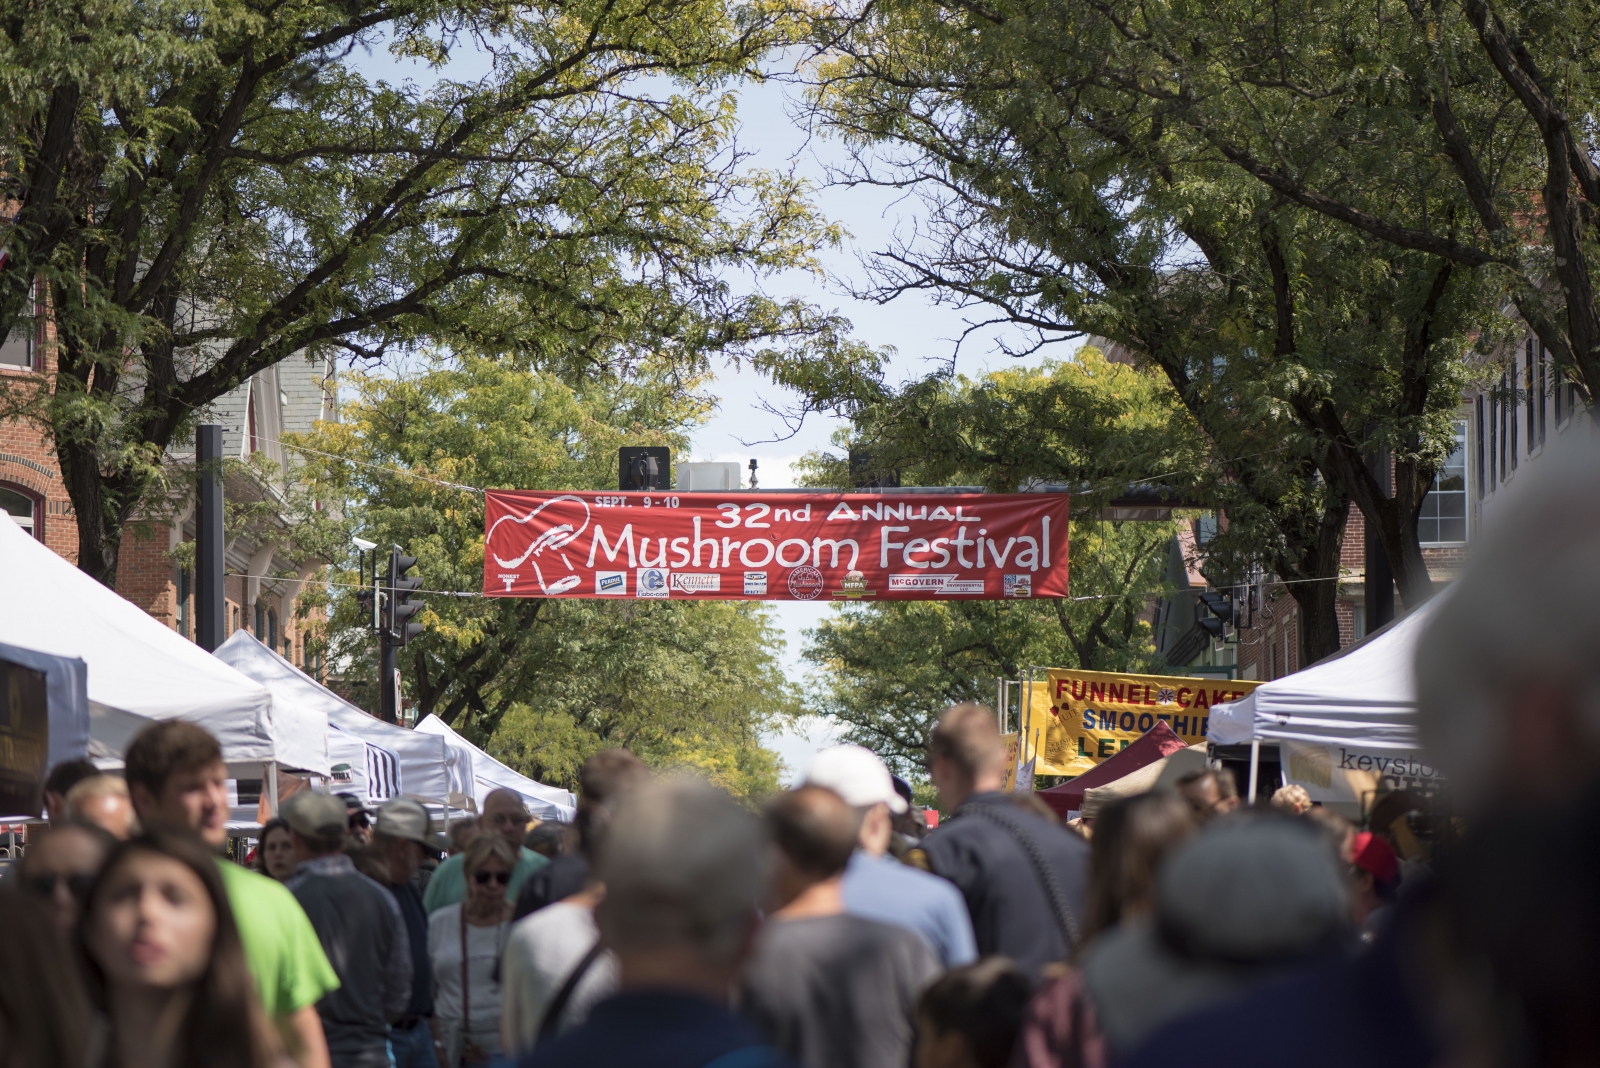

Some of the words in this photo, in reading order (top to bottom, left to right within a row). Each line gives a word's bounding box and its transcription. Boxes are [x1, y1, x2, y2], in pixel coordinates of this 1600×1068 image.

[595, 496, 633, 508] SEPT.
[715, 502, 811, 529] 32nd
[586, 516, 859, 572] Mushroom
[880, 516, 1051, 572] Festival
[792, 567, 820, 578] AMERICAN
[502, 578, 515, 592] T
[601, 577, 621, 586] PERDUE
[672, 573, 719, 588] Kennett
[791, 587, 821, 599] INSTITUTE
[1056, 679, 1157, 706] FUNNEL
[1082, 708, 1209, 737] SMOOHIE
[1337, 747, 1445, 779] keysto
